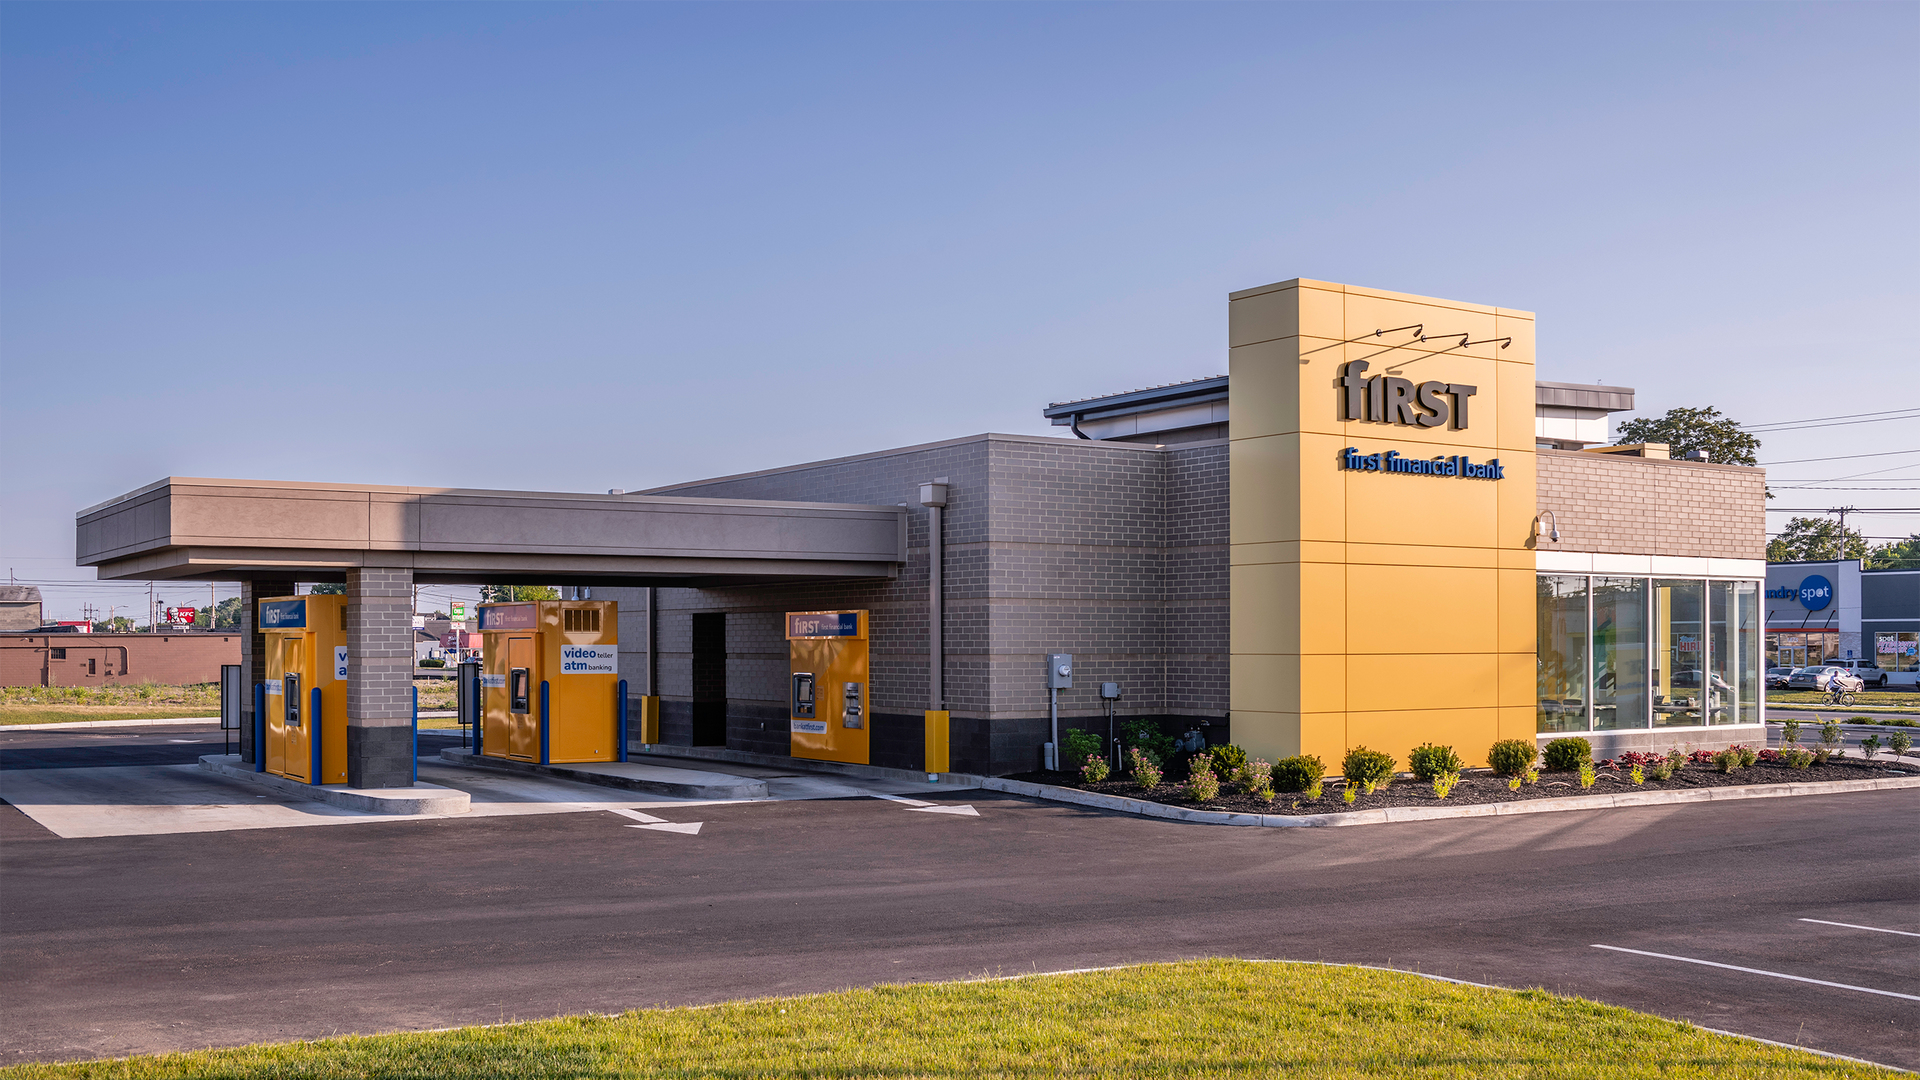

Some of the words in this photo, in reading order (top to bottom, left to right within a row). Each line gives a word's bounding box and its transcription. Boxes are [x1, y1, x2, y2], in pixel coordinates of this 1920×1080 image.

[1344, 447, 1383, 471] first
[1386, 450, 1459, 476] financial
[1462, 456, 1505, 480] bank
[1801, 586, 1829, 601] spot
[1679, 641, 1715, 652] HIRIG
[564, 647, 597, 659] video
[564, 661, 587, 671] atm
[588, 664, 613, 672] banking
